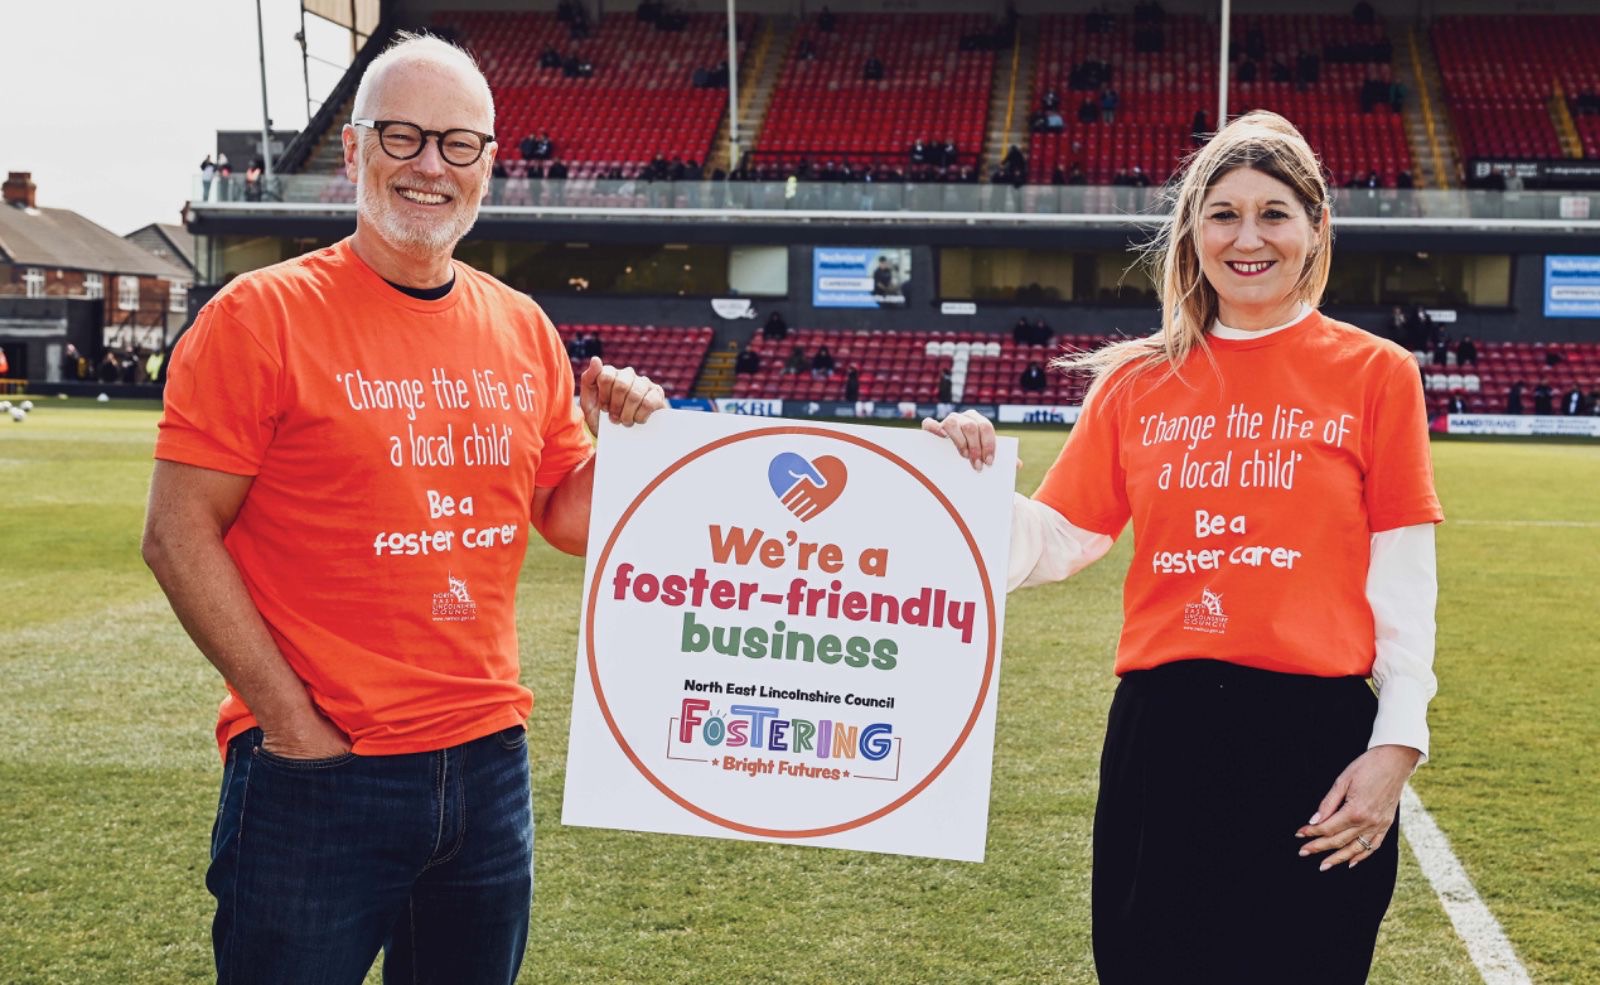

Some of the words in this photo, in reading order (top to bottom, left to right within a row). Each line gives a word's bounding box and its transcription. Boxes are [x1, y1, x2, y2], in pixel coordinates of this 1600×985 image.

[432, 367, 470, 410] the
[1226, 403, 1263, 440] the
[389, 435, 403, 467] a
[409, 423, 455, 467] local
[1158, 462, 1172, 490] a
[1179, 450, 1233, 489] local
[427, 490, 456, 519] Be
[459, 496, 474, 516] a
[373, 530, 455, 556] foster
[462, 523, 518, 549] carer
[1195, 509, 1226, 538] Be
[1229, 515, 1246, 534] a
[858, 548, 889, 577] a
[1152, 549, 1225, 574] foster
[1228, 545, 1302, 570] carer
[613, 563, 976, 644] foster-friendly
[1183, 618, 1226, 629] COUNCIL
[681, 612, 899, 671] business
[684, 679, 723, 694] North
[726, 683, 757, 697] East
[759, 686, 841, 704] Lincolnshire
[844, 693, 895, 709] Council
[679, 698, 893, 761] FOSTERING
[723, 756, 775, 777] Bright
[778, 761, 841, 780] Futures
